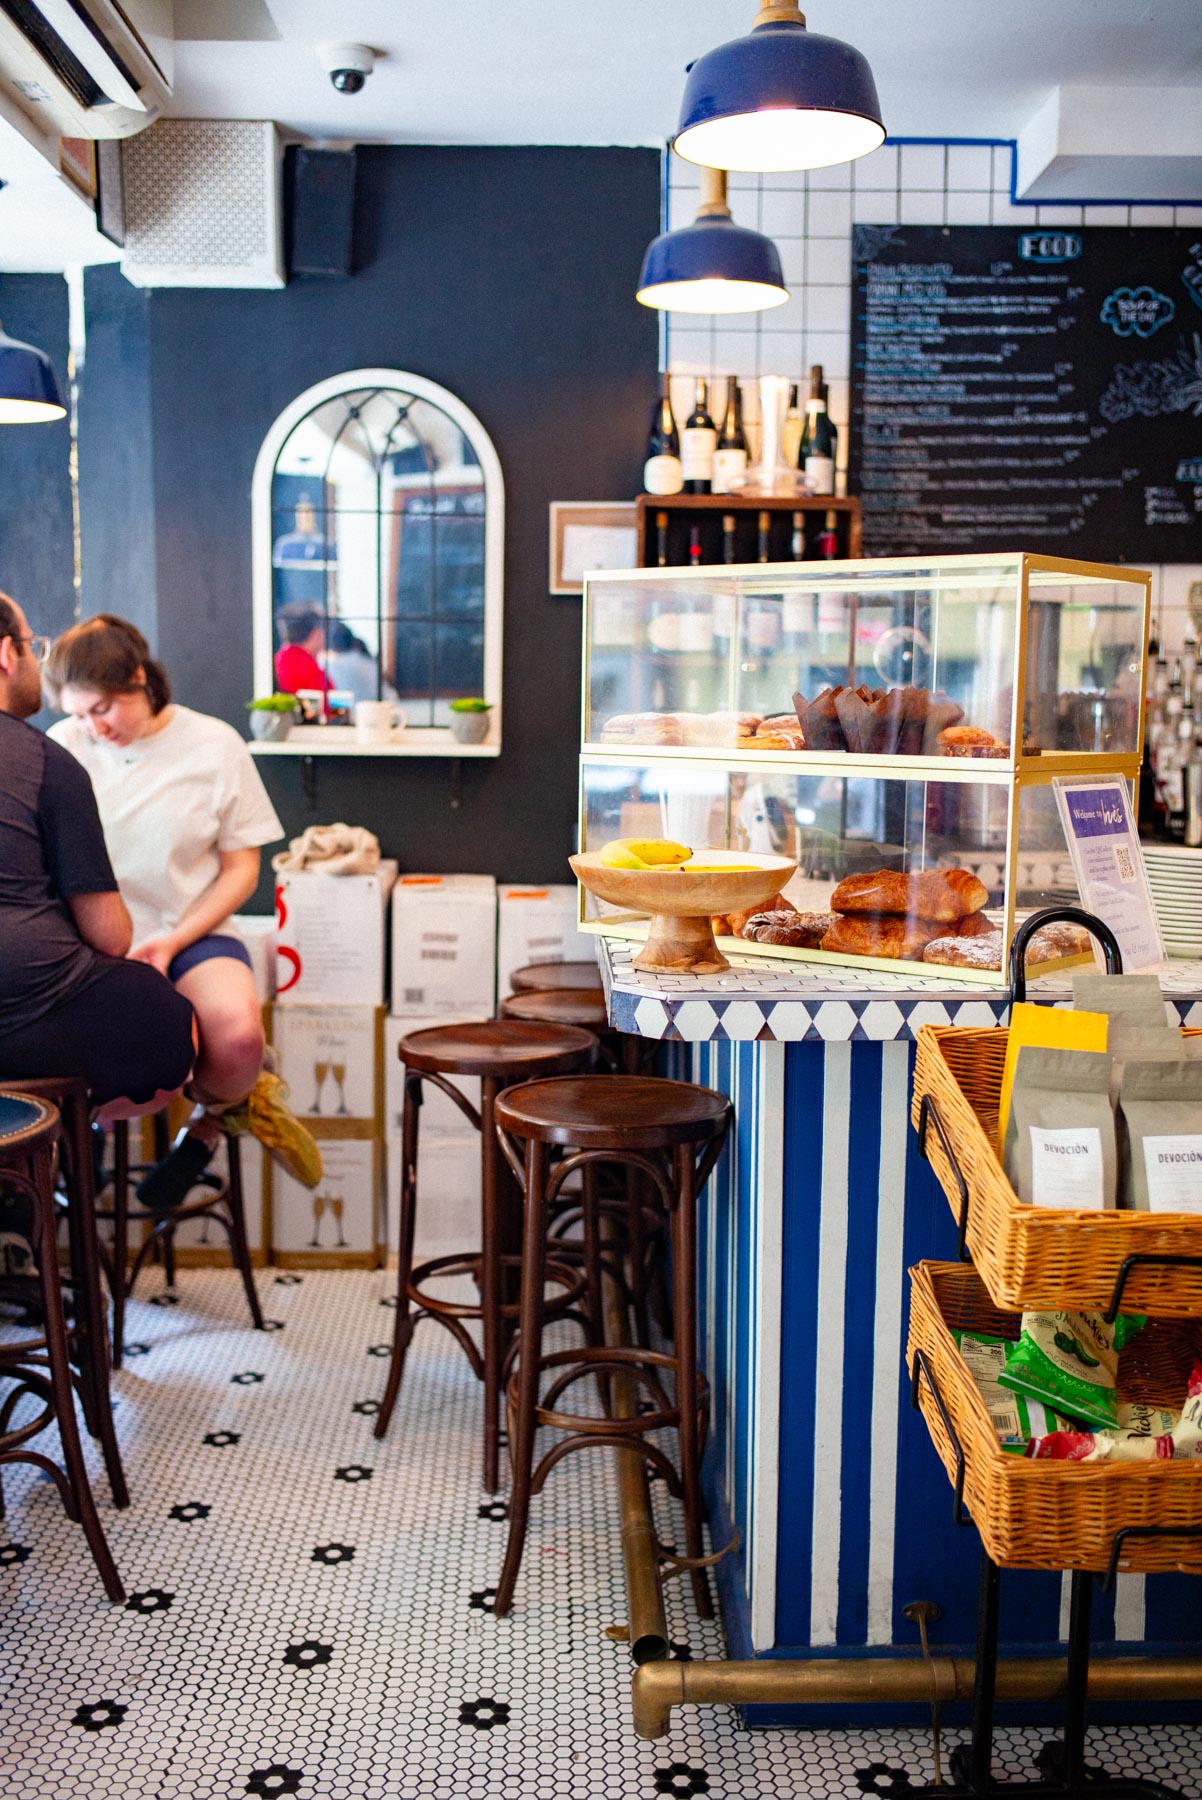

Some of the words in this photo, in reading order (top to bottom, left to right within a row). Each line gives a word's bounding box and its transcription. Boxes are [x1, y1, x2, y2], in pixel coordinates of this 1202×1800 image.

[1022, 236, 1080, 257] FOOD
[1073, 809, 1095, 820] Welcome
[1043, 1143, 1089, 1154] DEVOCIÓN
[1158, 1150, 1202, 1163] DEVOCIÓN
[1121, 1403, 1156, 1440] Vickie'
